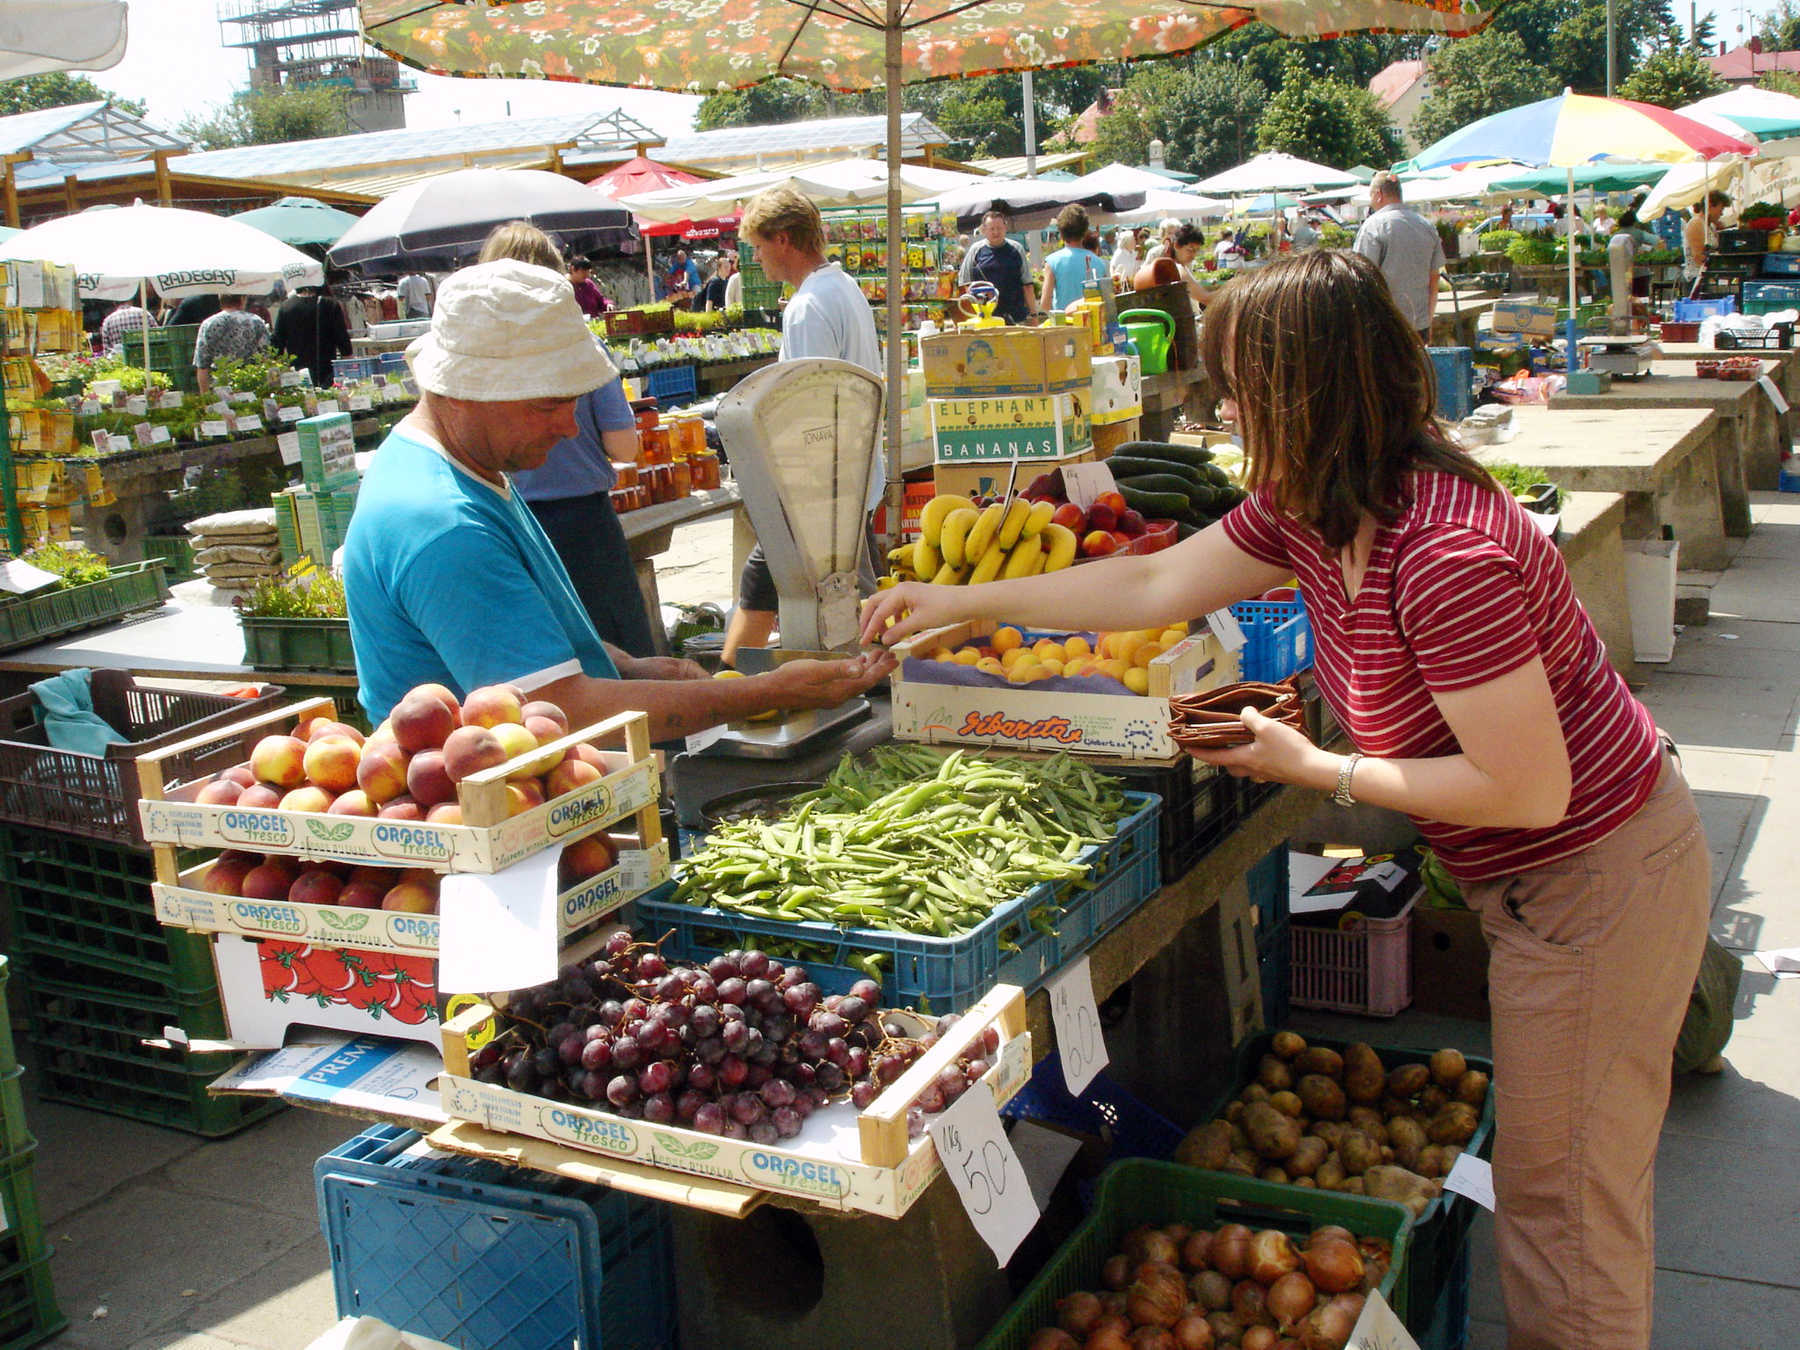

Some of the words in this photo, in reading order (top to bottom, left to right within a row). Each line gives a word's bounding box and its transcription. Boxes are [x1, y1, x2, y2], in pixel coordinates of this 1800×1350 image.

[157, 269, 238, 288] RADEGAST
[940, 398, 1048, 416] ELEPHANT
[943, 440, 1051, 457] BANANAS
[551, 791, 605, 825] OROL
[225, 813, 288, 832] OROGEL
[245, 824, 287, 843] fresco
[376, 825, 444, 849] OROGEL
[400, 838, 447, 857] fresco
[566, 878, 619, 915] OROGEL
[236, 903, 300, 923] OROGEL
[256, 914, 300, 932] fresco
[394, 917, 440, 937] OROG
[552, 1110, 631, 1142] OROGEL
[574, 1126, 628, 1151] fresco
[753, 1152, 841, 1185] OROGEL
[776, 1168, 840, 1194] fresco
